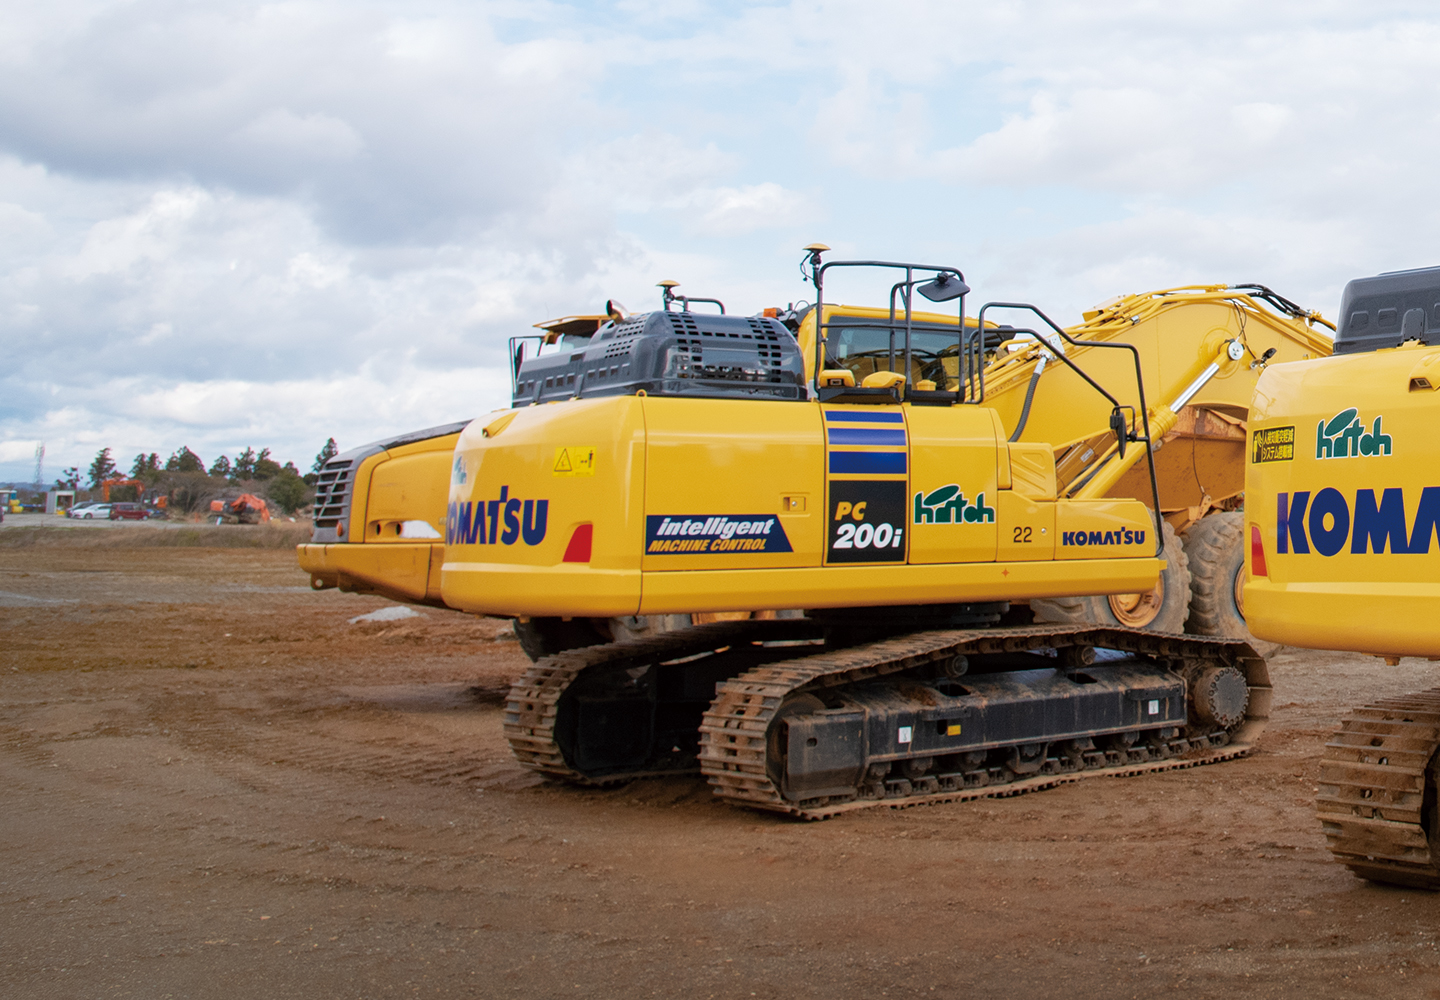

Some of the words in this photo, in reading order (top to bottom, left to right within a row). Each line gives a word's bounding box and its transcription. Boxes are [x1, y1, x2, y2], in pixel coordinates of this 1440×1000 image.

[446, 485, 549, 546] OMATSU
[834, 501, 867, 521] PC
[656, 517, 775, 540] intelligent
[832, 522, 903, 549] 200i
[1013, 526, 1033, 543] 22
[1062, 526, 1146, 546] KOMATSU
[648, 539, 711, 552] MACHINE
[710, 538, 767, 551] CONTROL
